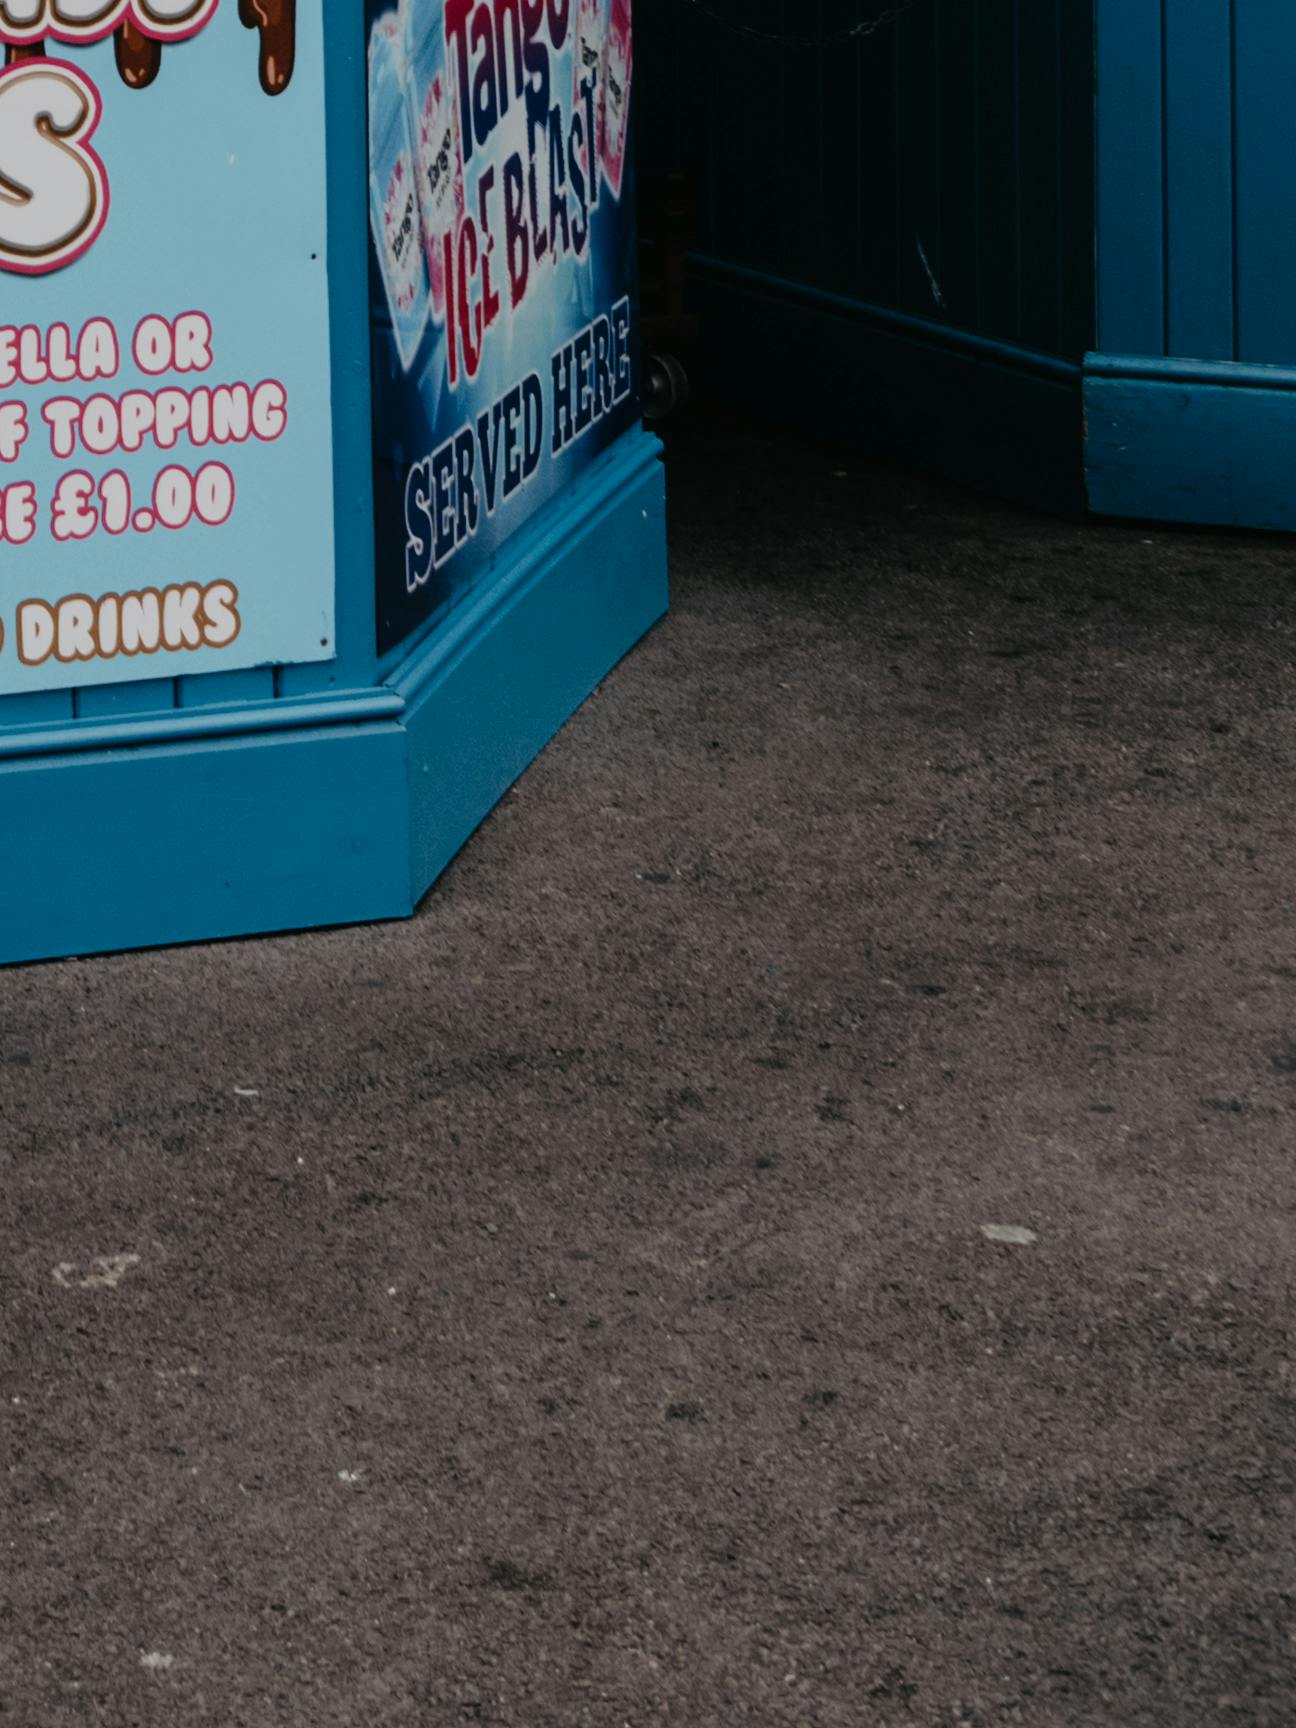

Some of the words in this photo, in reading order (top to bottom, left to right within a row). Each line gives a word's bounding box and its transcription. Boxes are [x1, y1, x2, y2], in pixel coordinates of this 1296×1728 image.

[443, 166, 500, 388] ICE
[506, 70, 600, 312] BLAST
[133, 311, 213, 374] OR
[41, 379, 287, 460] TOPPING
[406, 372, 541, 591] SERVED
[551, 296, 631, 460] HERE
[50, 461, 235, 545] £1.00
[15, 578, 240, 667] DRINKS
